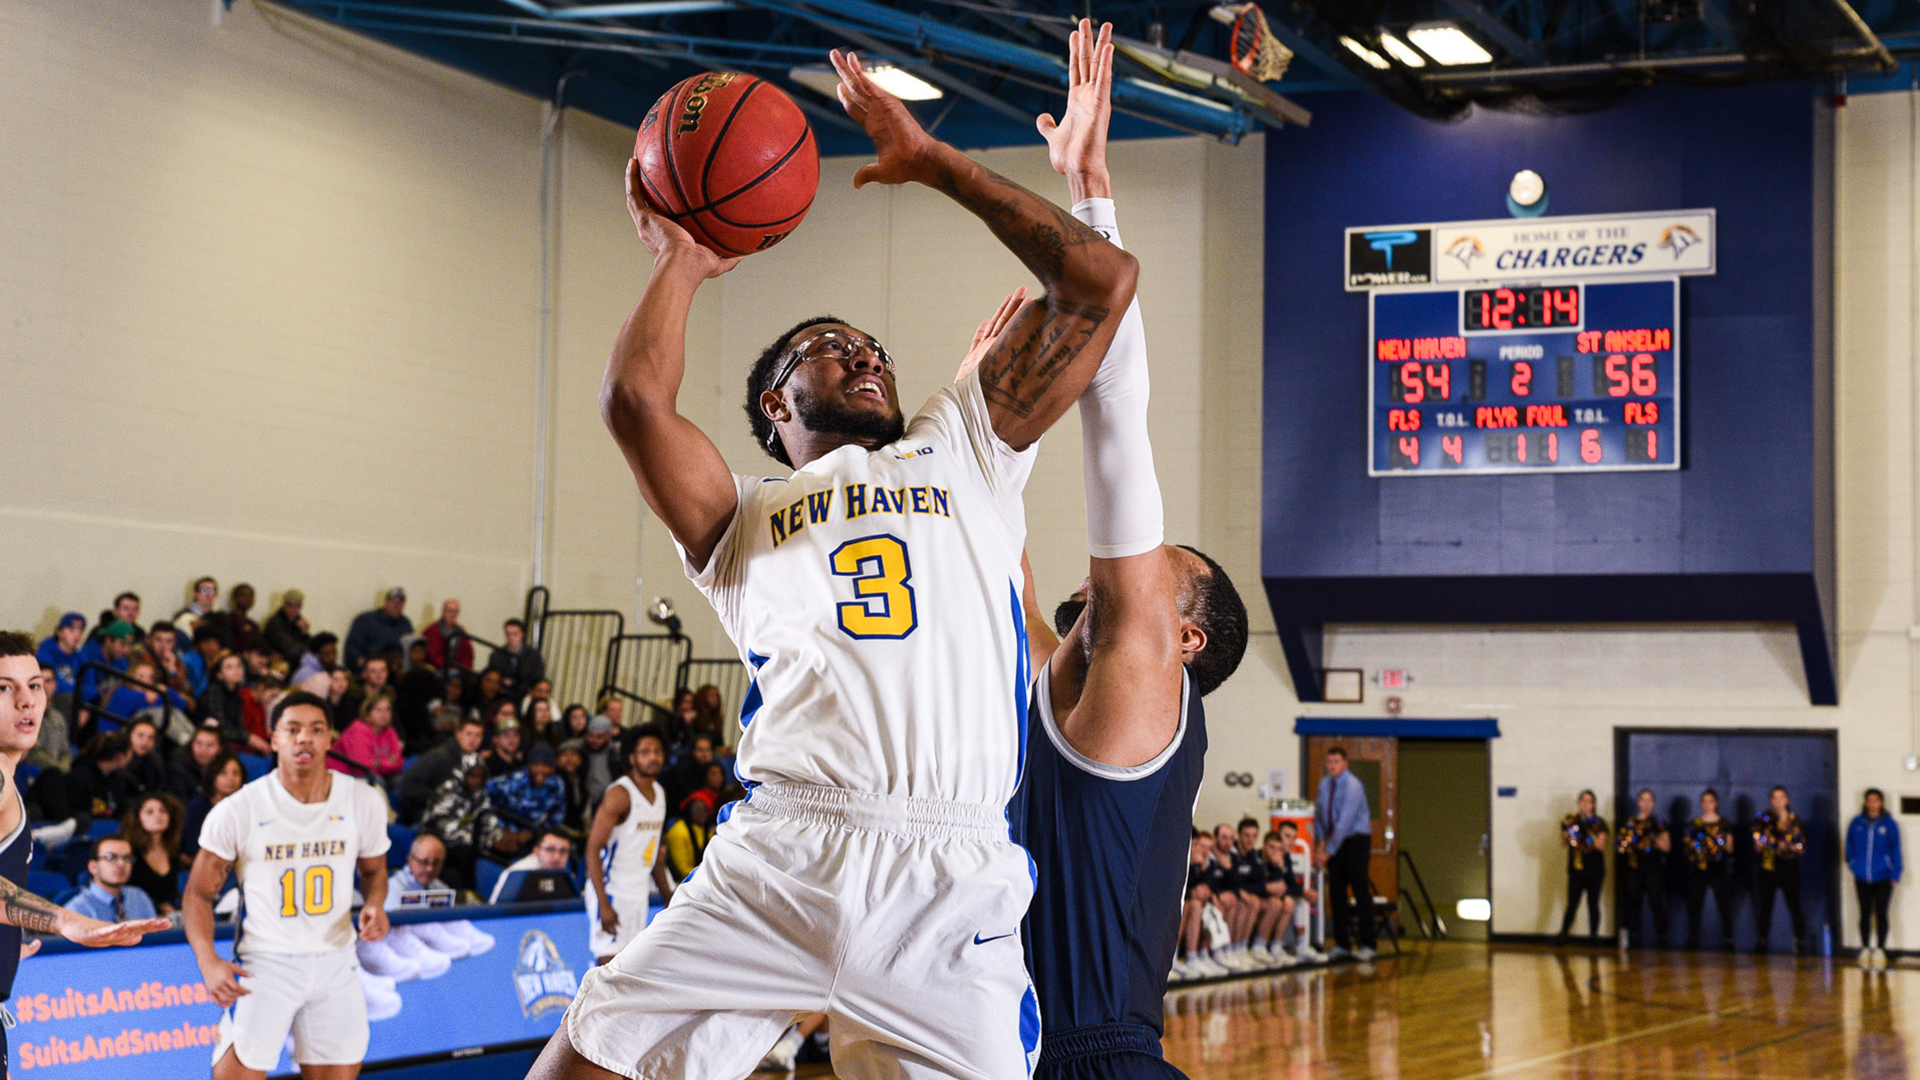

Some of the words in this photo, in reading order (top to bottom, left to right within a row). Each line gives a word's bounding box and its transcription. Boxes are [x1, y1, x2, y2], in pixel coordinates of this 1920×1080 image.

[678, 71, 738, 137] lson
[1513, 231, 1561, 244] HOME
[1568, 229, 1587, 241] OF
[1596, 226, 1629, 239] THE
[1496, 243, 1647, 270] CHARGERS
[1481, 288, 1578, 330] 12:14
[1377, 338, 1411, 361] NEW
[1413, 336, 1467, 360] HAVEN
[1499, 345, 1543, 360] PERIOD
[1577, 330, 1602, 354] ST
[1604, 328, 1671, 352] ANSELM
[1400, 361, 1450, 404] 54
[1511, 362, 1532, 396] 2
[1605, 353, 1657, 397] 56
[1388, 408, 1421, 431] FLS
[1476, 406, 1518, 428] PLYR
[1526, 404, 1568, 427] FOUL
[1624, 402, 1658, 425] FLS
[1399, 436, 1419, 465] 4
[1442, 435, 1463, 464] 4
[1581, 429, 1602, 464] 6
[1647, 430, 1657, 459] 1
[770, 488, 834, 550] NEW
[845, 483, 951, 521] HAVEN
[828, 533, 918, 640] 3
[264, 844, 297, 861] NEW
[301, 839, 347, 859] HAVEN
[280, 864, 334, 918] 10
